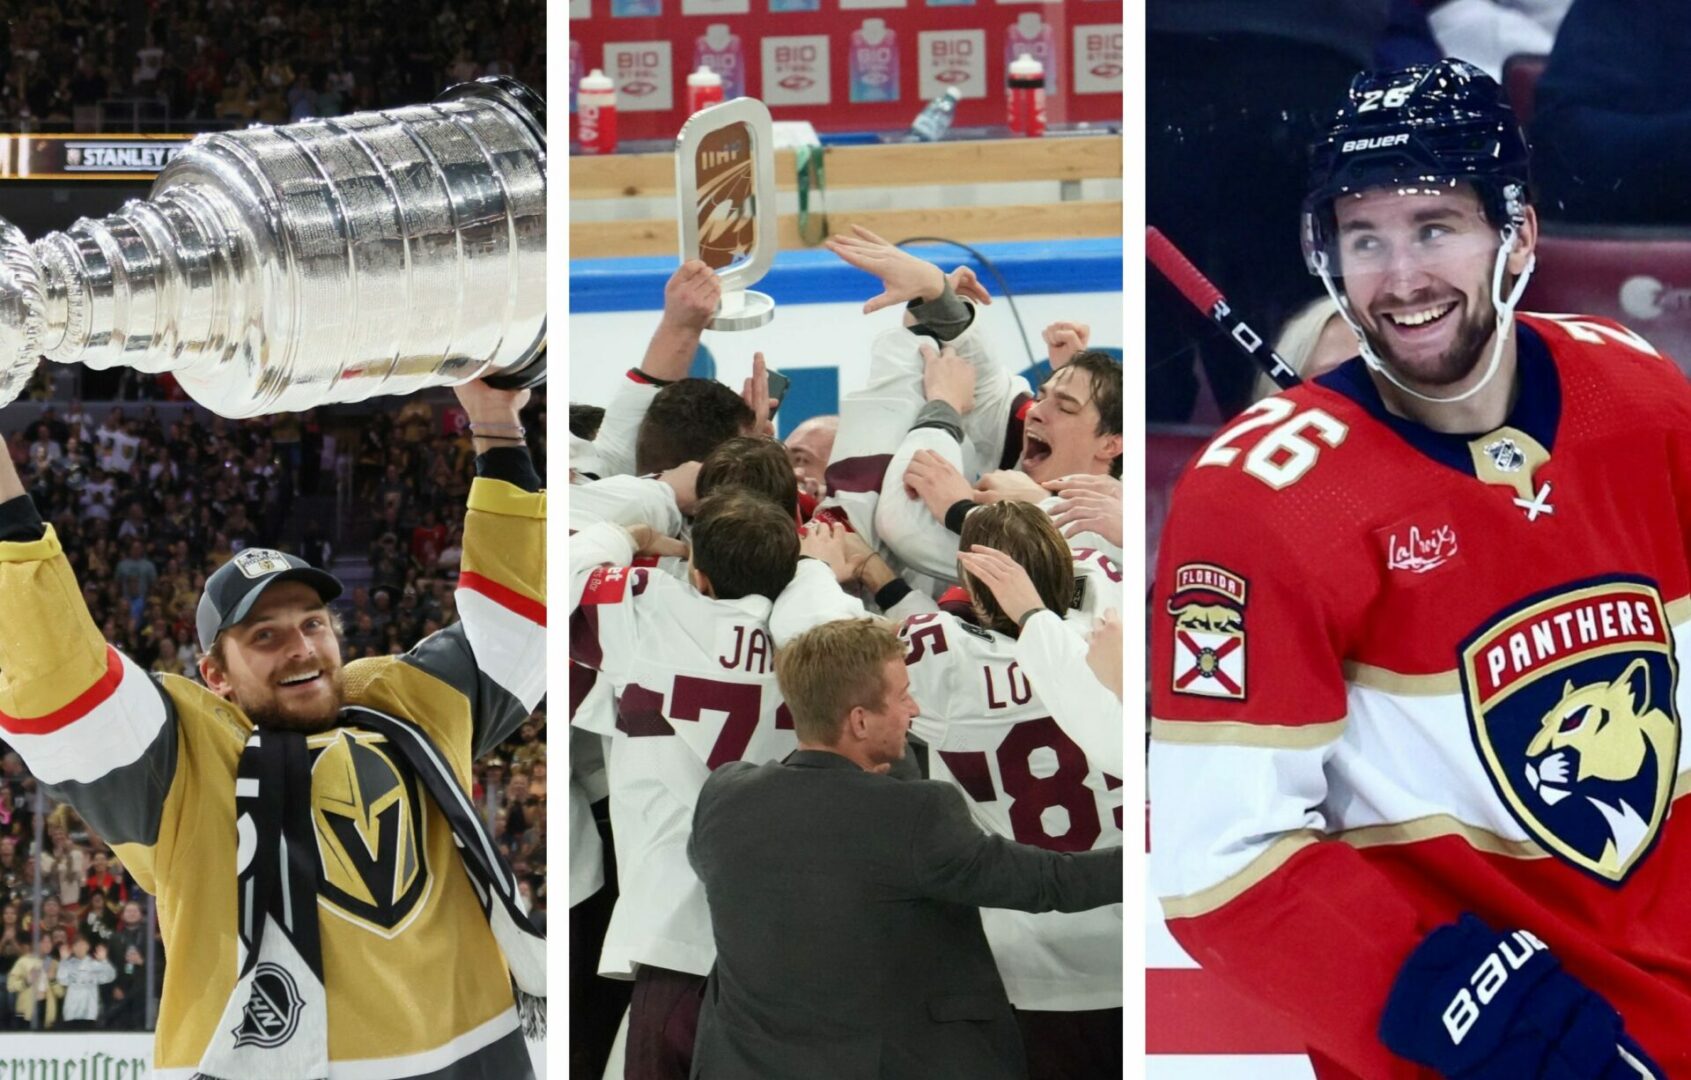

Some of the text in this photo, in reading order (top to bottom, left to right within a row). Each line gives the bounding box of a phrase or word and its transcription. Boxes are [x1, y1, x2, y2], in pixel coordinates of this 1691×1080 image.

[775, 45, 816, 62] BIO
[857, 48, 891, 62] BIO
[931, 39, 972, 57] BIO
[617, 51, 659, 68] BIO
[1357, 82, 1418, 113] 26
[1342, 133, 1410, 153] BAUER
[83, 148, 165, 166] STANLEY
[1196, 396, 1350, 492] 26
[605, 568, 623, 583] et
[1181, 569, 1238, 594] FLORIDA
[719, 626, 776, 674] JA
[1486, 599, 1656, 687] PANTHERS
[983, 662, 1032, 710] LO
[669, 674, 795, 772] 7
